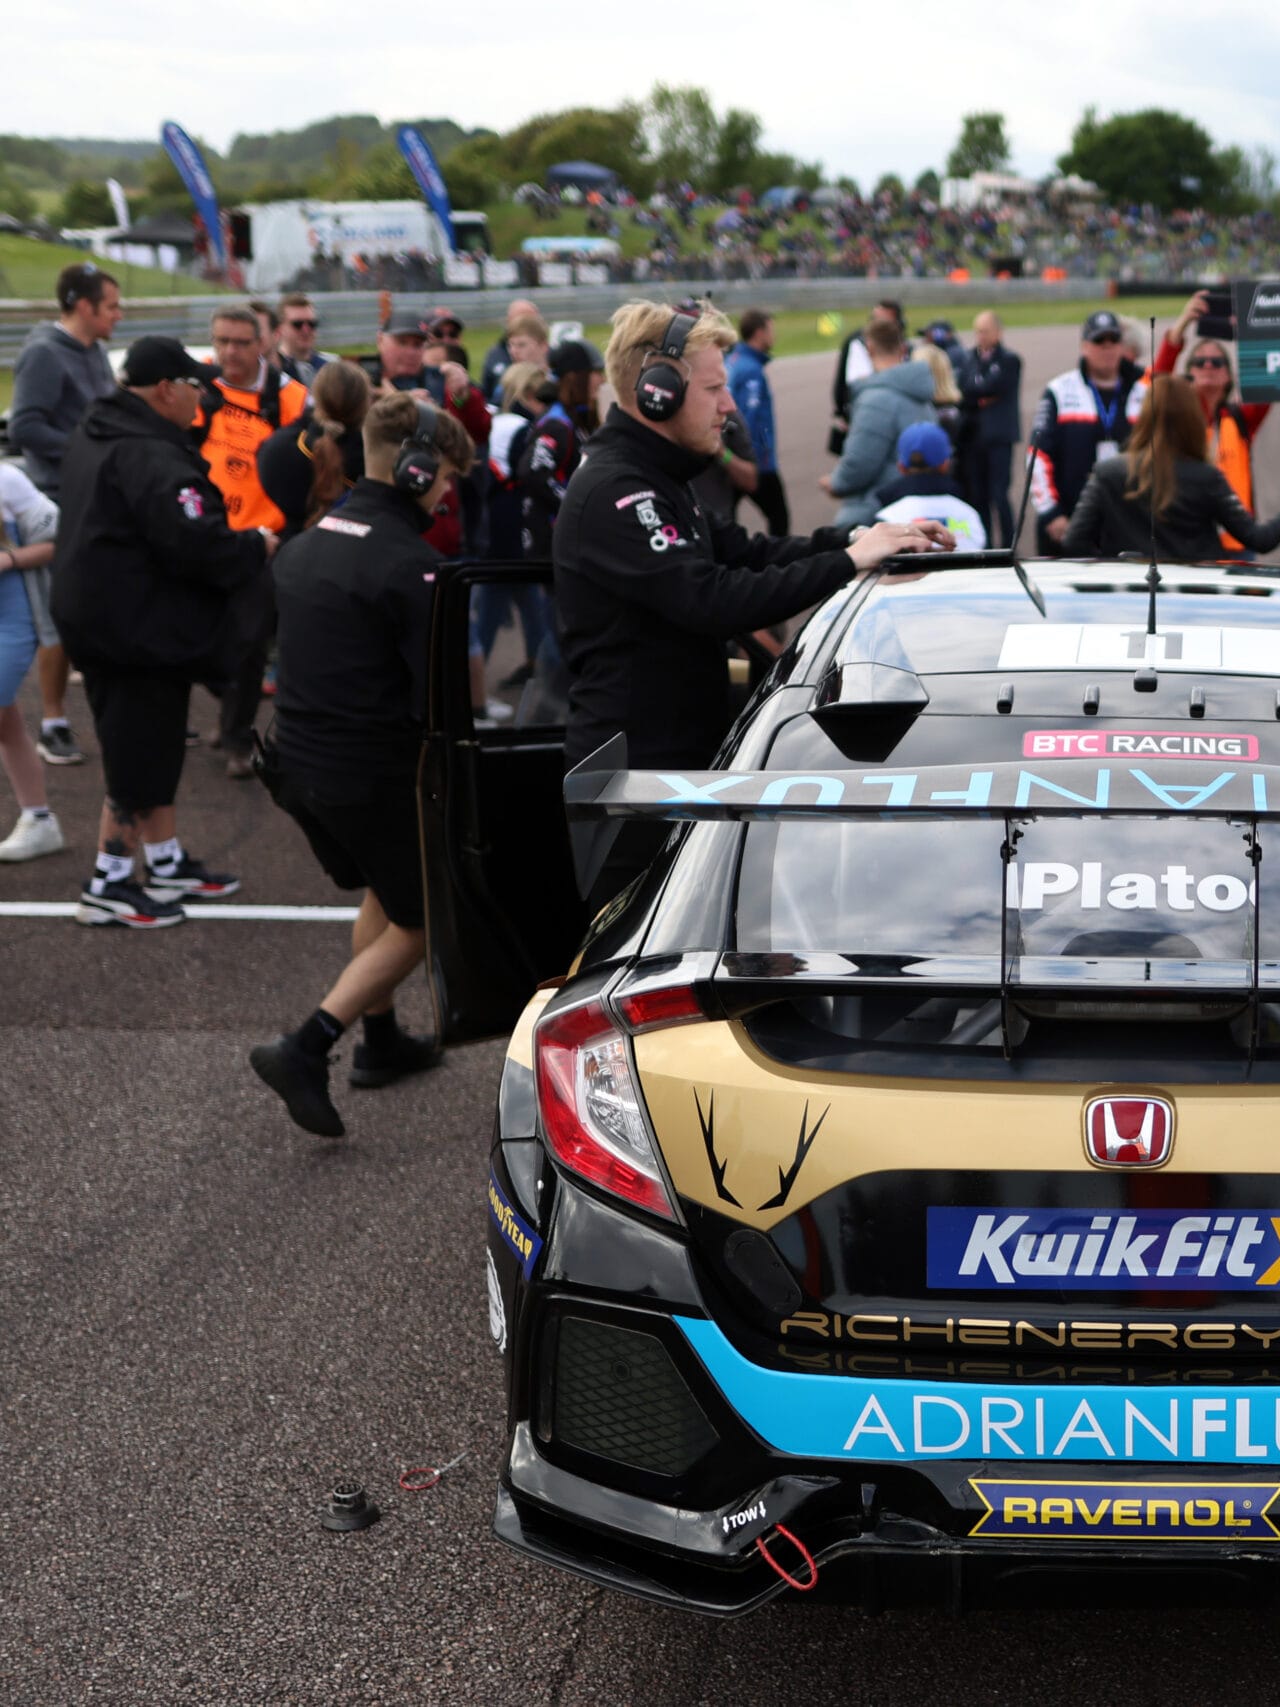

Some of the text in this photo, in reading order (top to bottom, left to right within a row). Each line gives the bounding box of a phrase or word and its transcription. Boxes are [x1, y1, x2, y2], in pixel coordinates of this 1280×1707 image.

[1120, 631, 1184, 660] 11
[1032, 734, 1243, 756] BTC RACING
[1021, 861, 1248, 912] Plato
[488, 1179, 534, 1261] OODYEAR
[729, 1505, 759, 1529] TOW
